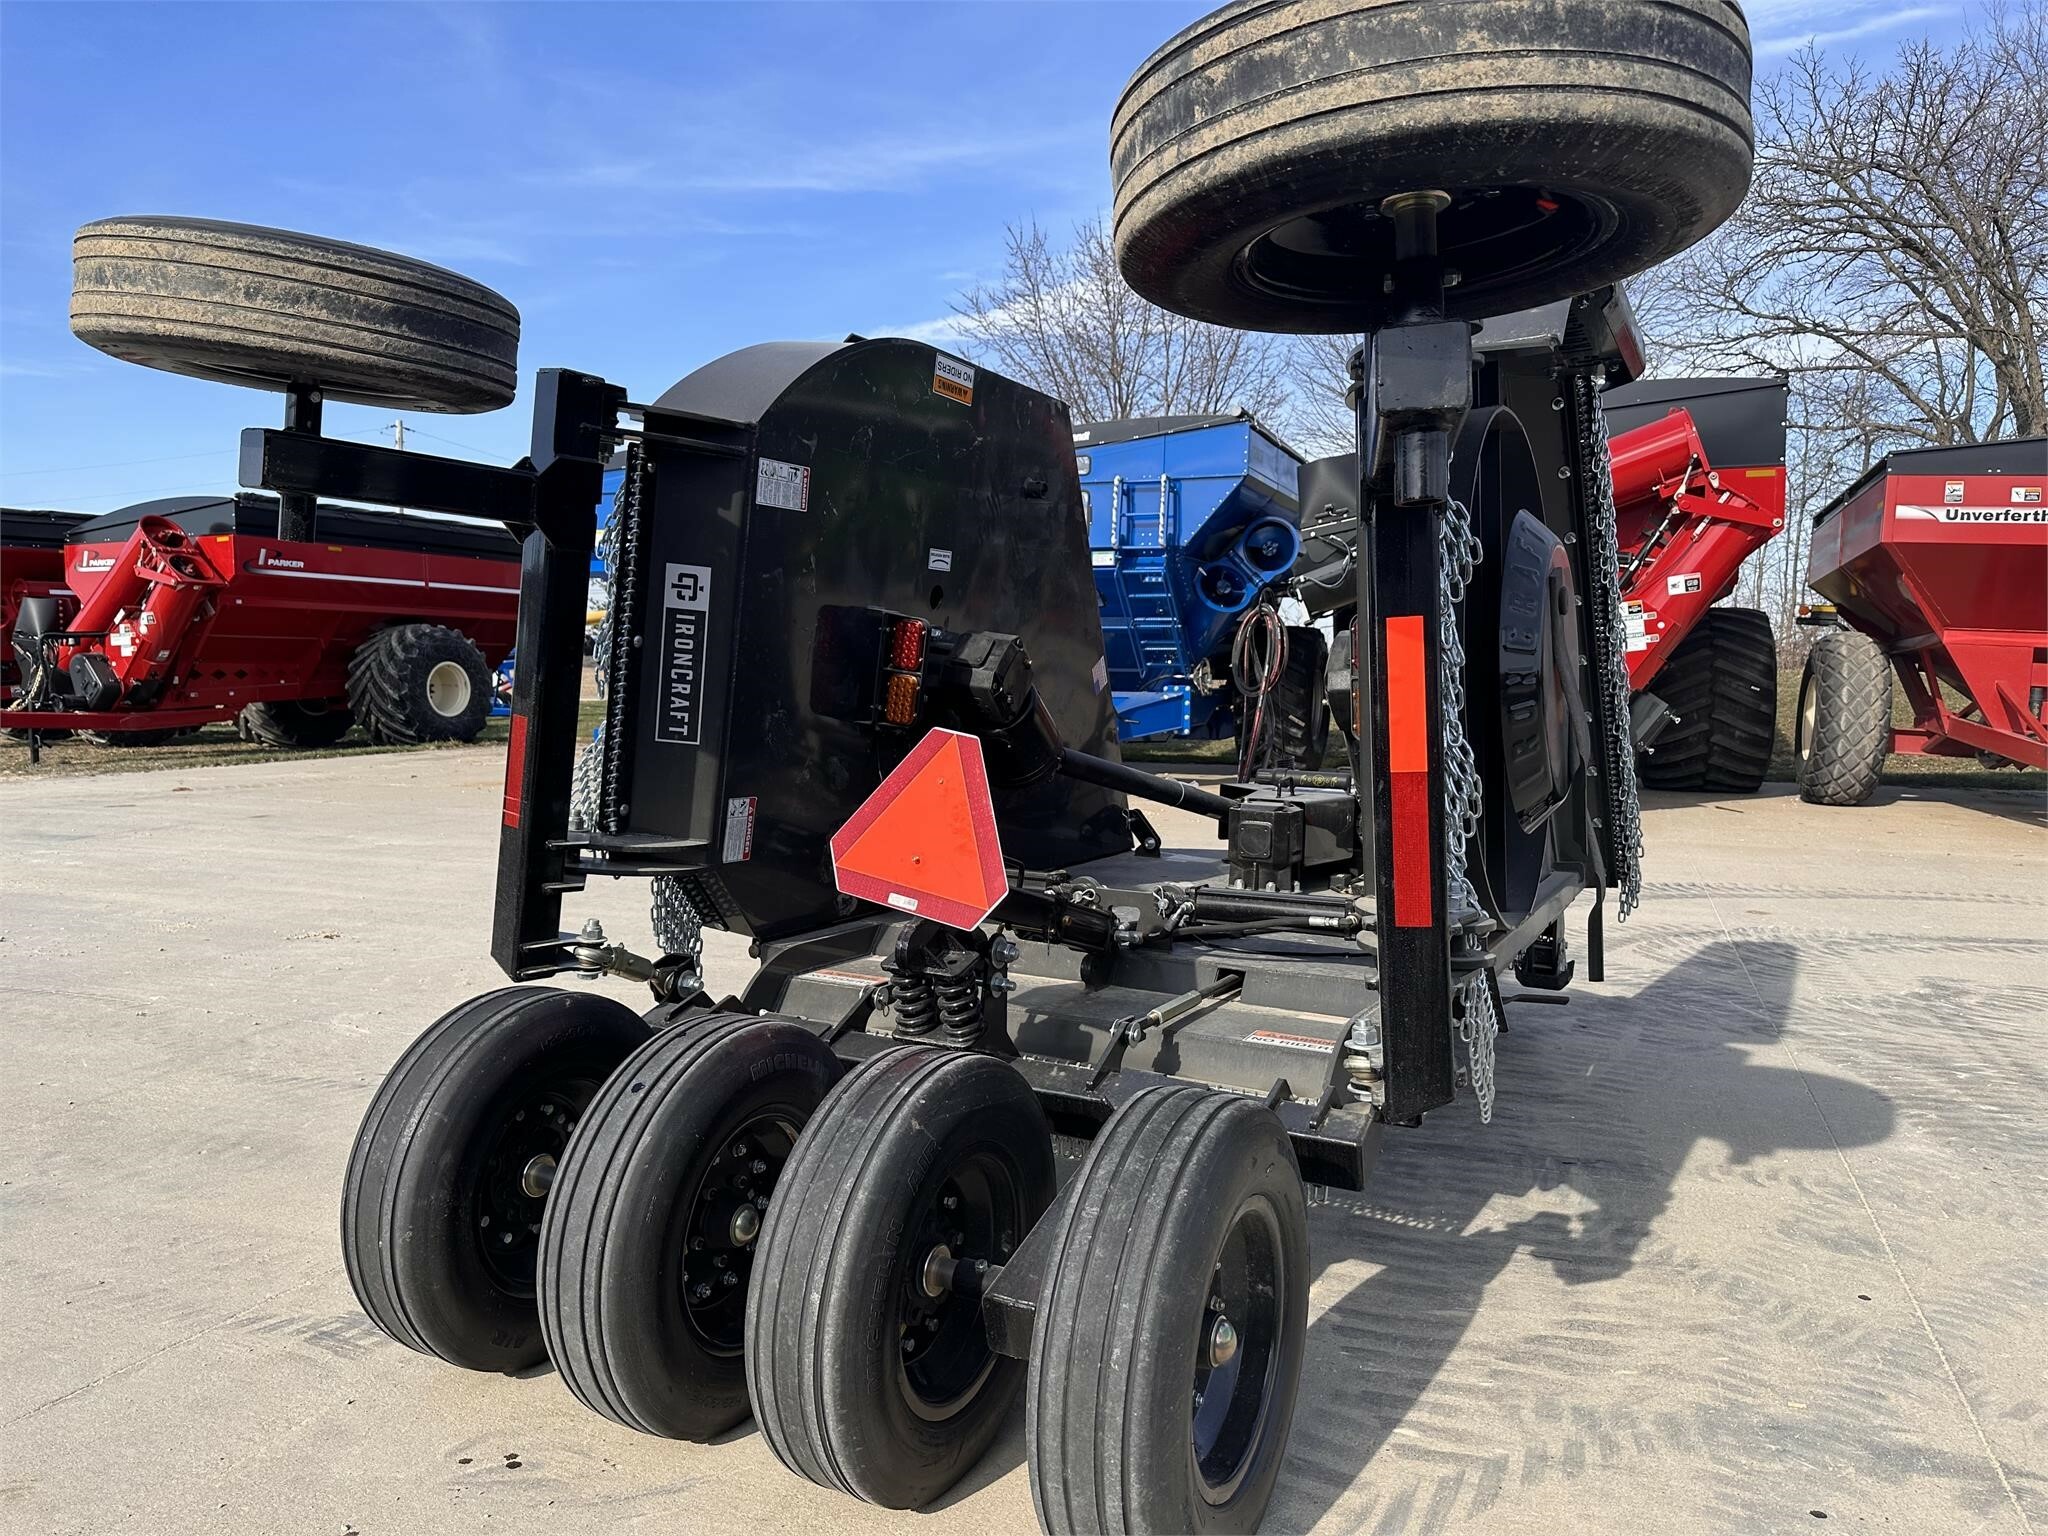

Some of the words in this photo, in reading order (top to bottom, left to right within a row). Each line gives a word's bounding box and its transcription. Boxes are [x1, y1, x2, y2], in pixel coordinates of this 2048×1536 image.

[937, 361, 962, 379] RIDERS
[962, 371, 972, 383] NO
[267, 558, 304, 569] PARKER
[668, 613, 696, 737] IRONCRAFT
[744, 815, 753, 854] DANGER
